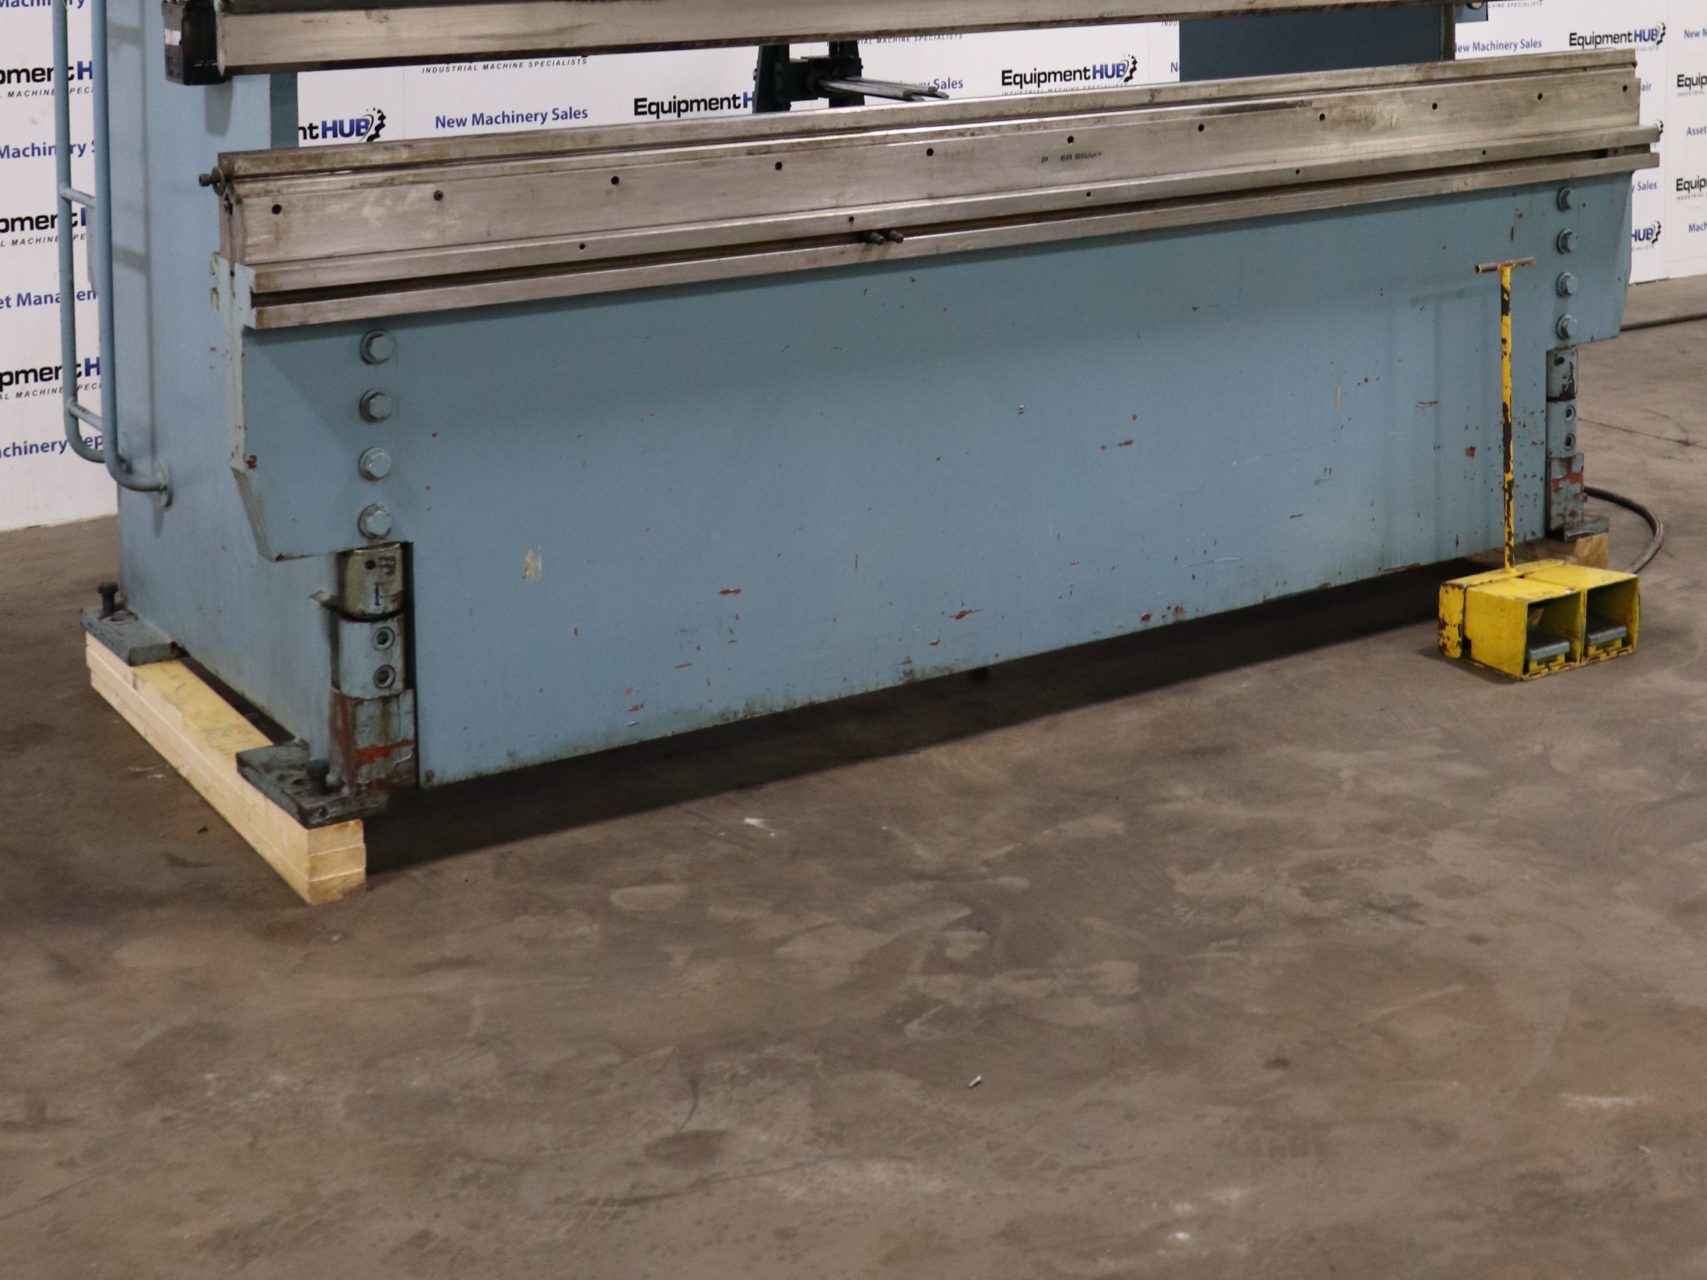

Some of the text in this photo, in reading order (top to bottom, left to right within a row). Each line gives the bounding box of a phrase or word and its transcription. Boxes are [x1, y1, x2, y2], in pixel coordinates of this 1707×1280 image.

[1569, 28, 1659, 49] EquipmentHUB
[1683, 29, 1701, 39] New
[1472, 39, 1518, 52] Machinery
[1520, 37, 1542, 49] Sales
[421, 58, 587, 74] INDUSTRIAL MACHINE SPECIALISTS
[933, 77, 963, 90] Sales
[1001, 63, 1126, 89] EquipmentHUB
[435, 106, 588, 129] New Machinery Sales
[1637, 180, 1657, 192] Sales
